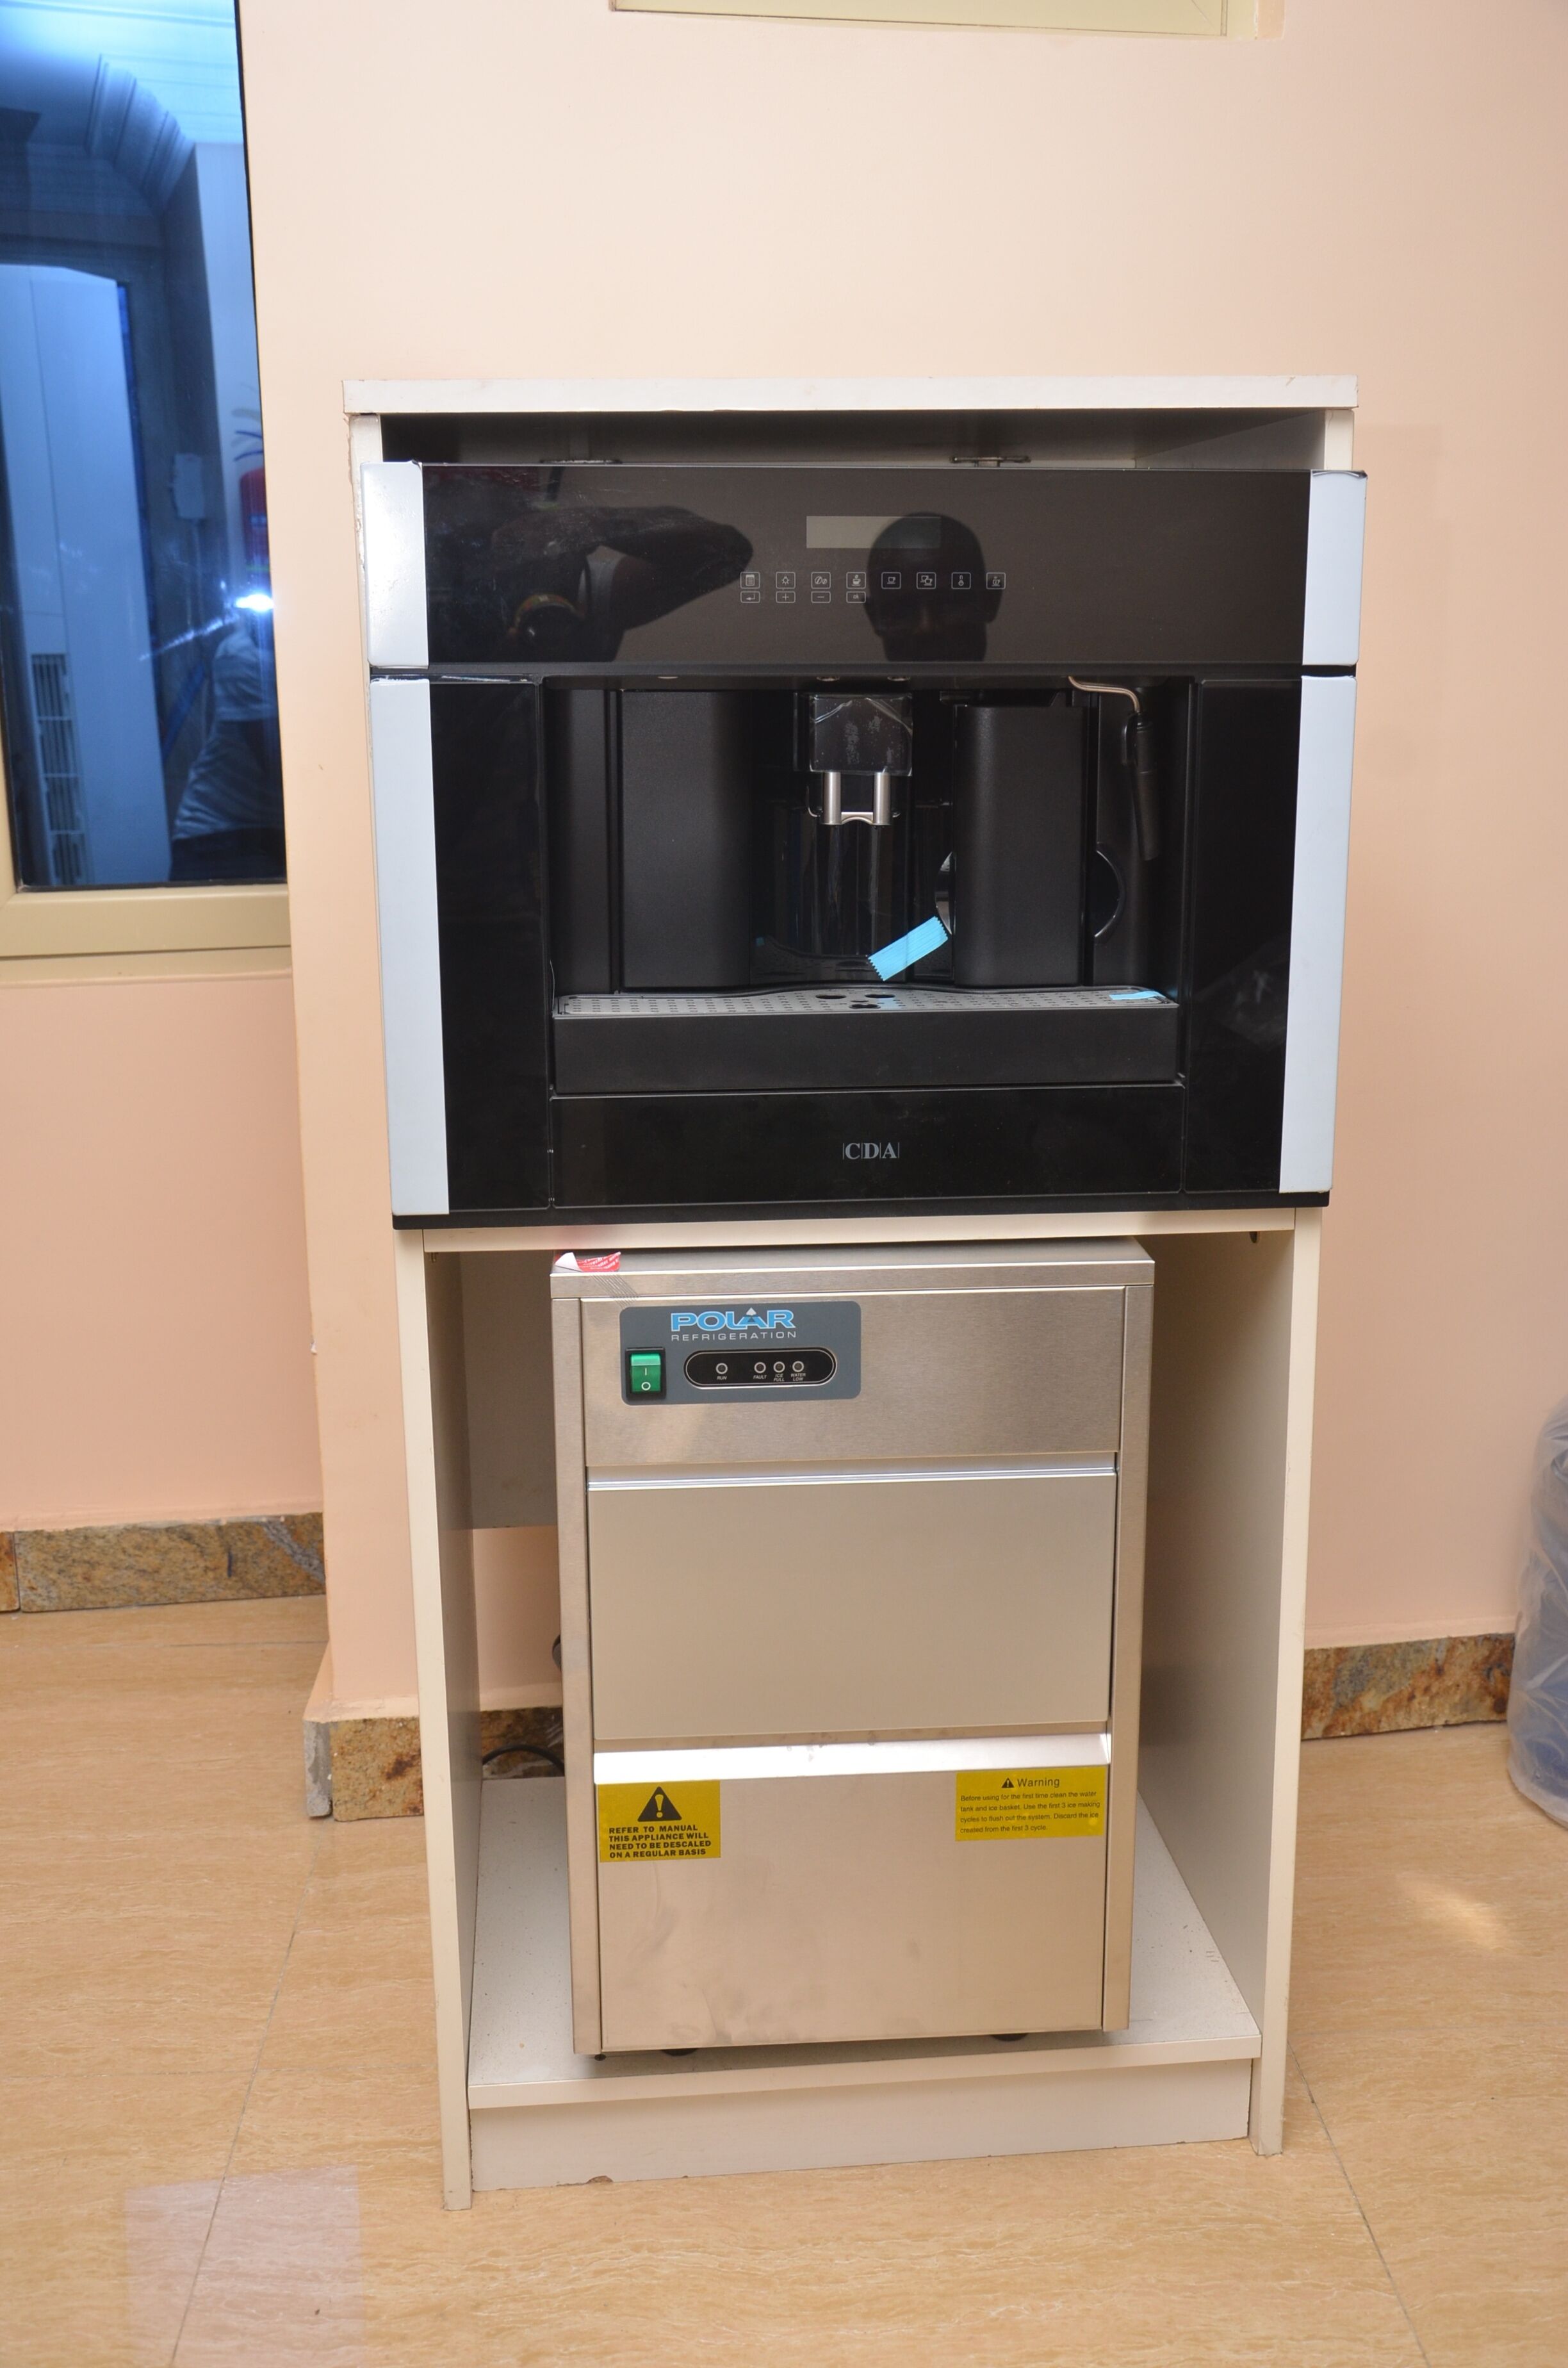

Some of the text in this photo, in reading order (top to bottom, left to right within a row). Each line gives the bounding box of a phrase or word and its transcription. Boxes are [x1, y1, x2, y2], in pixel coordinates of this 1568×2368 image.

[844, 1142, 897, 1160] CDA
[671, 1308, 796, 1332] POLAR
[671, 1331, 796, 1342] REFRIGERATION
[1017, 1777, 1060, 1788] Warning
[632, 1833, 684, 1841] APPLIANCE
[663, 1840, 712, 1848] DESCALED
